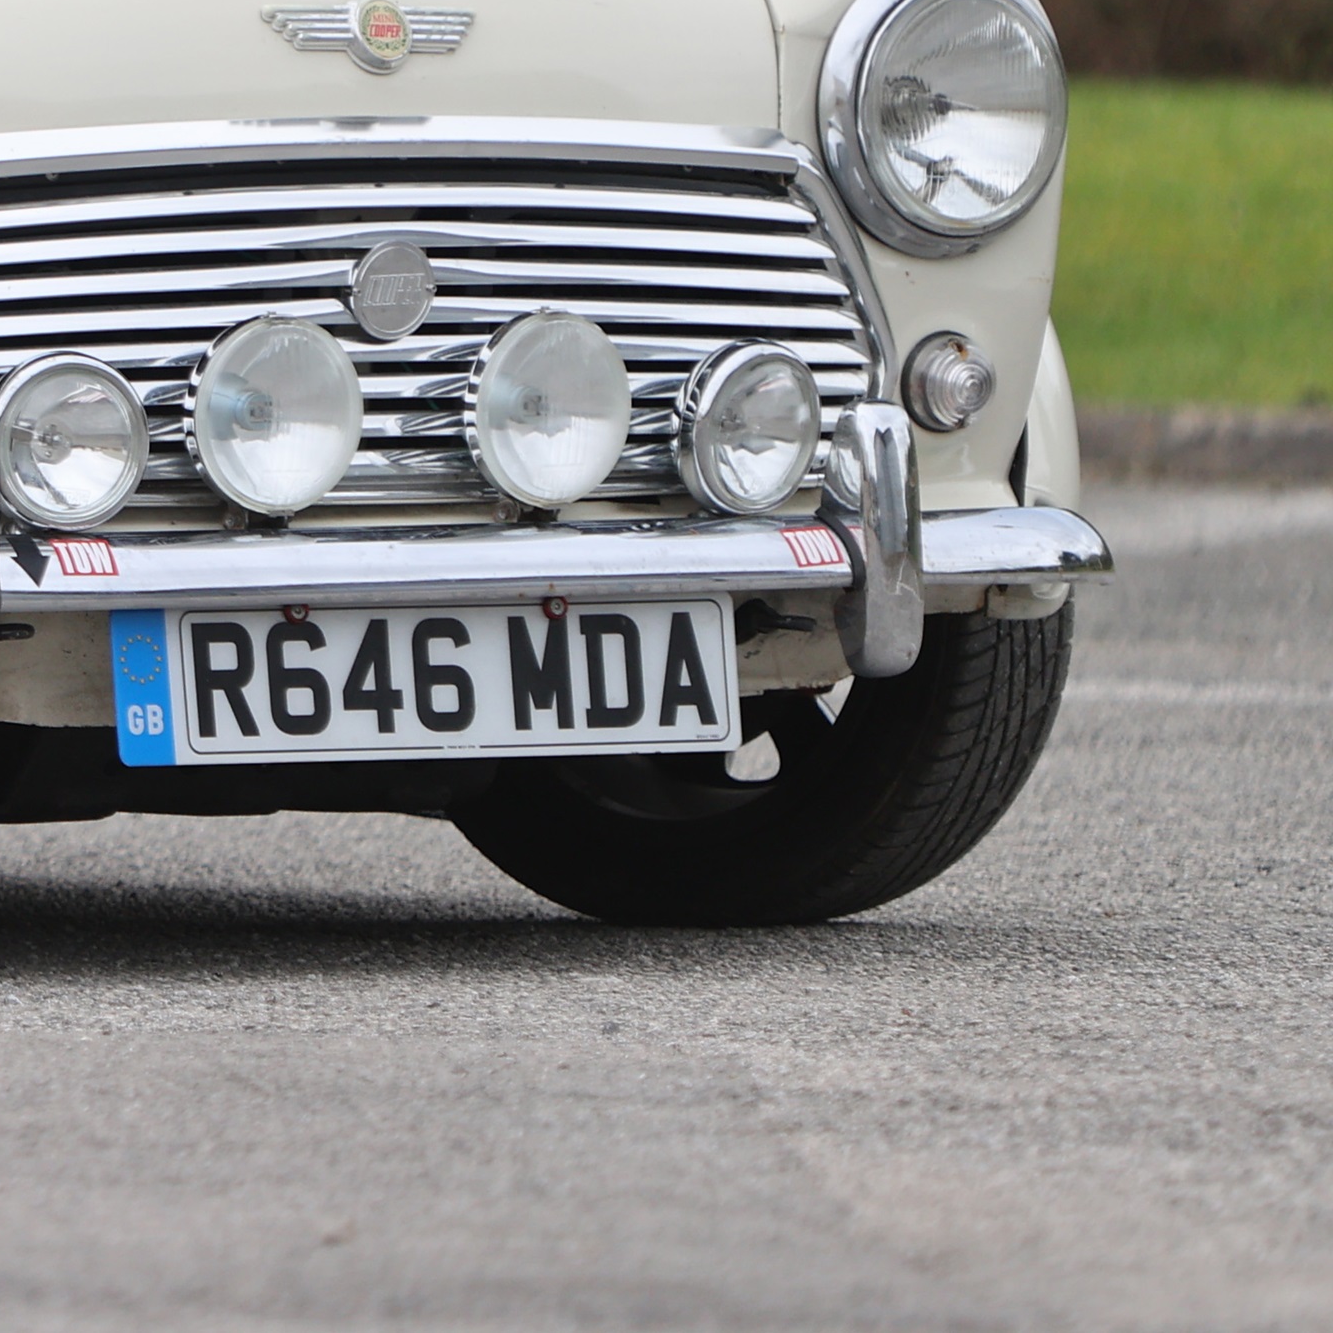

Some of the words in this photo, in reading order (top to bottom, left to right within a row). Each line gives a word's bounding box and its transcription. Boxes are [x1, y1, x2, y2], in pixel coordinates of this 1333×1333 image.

[368, 23, 403, 39] COOPER
[53, 540, 114, 575] TOW
[781, 529, 840, 566] TOW
[190, 617, 476, 740] R646
[507, 611, 719, 732] MDA
[127, 703, 165, 738] GB
